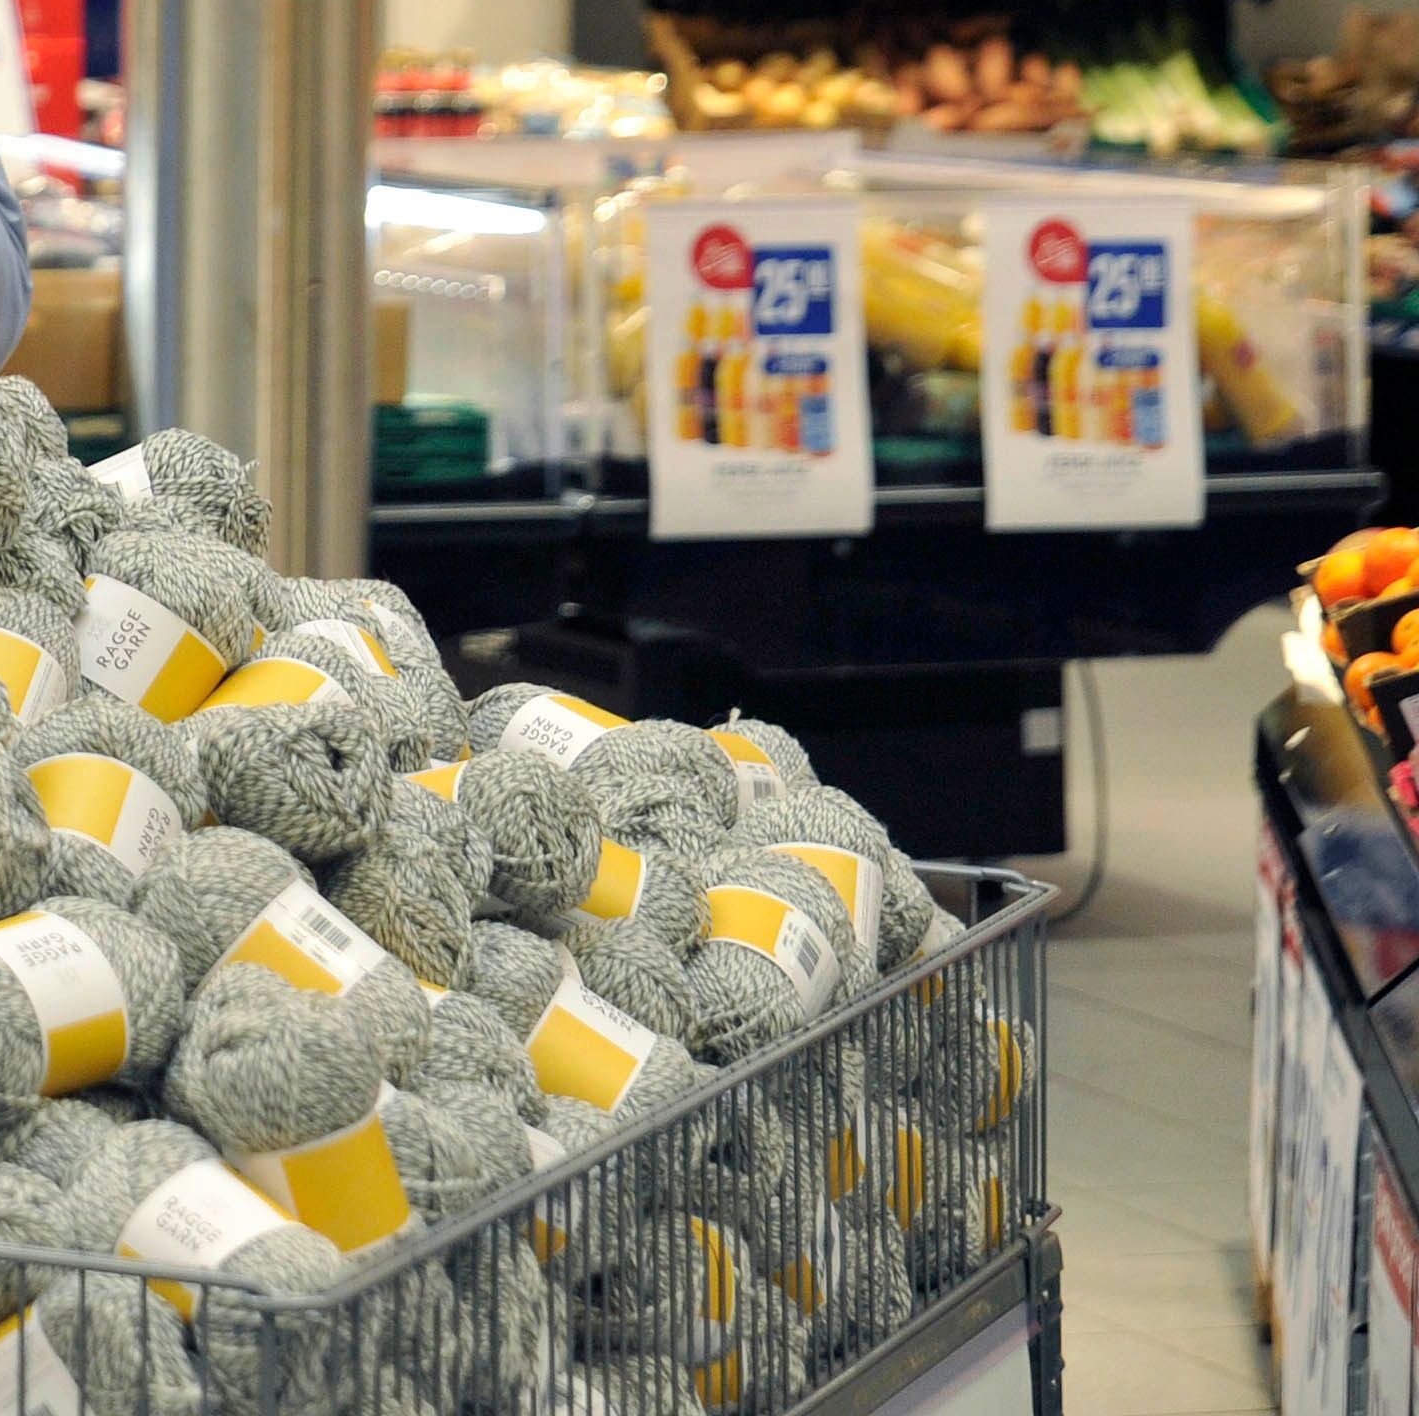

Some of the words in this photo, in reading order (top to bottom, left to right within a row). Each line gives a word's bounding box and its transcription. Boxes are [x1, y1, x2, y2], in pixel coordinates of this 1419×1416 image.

[95, 608, 141, 668] RAGGE
[114, 622, 152, 670] GARN
[519, 723, 569, 755] RAGGE
[531, 716, 573, 741] GARN
[138, 807, 159, 857] GARN
[155, 1213, 201, 1253] GARN
[163, 1194, 222, 1243] RAGGE
